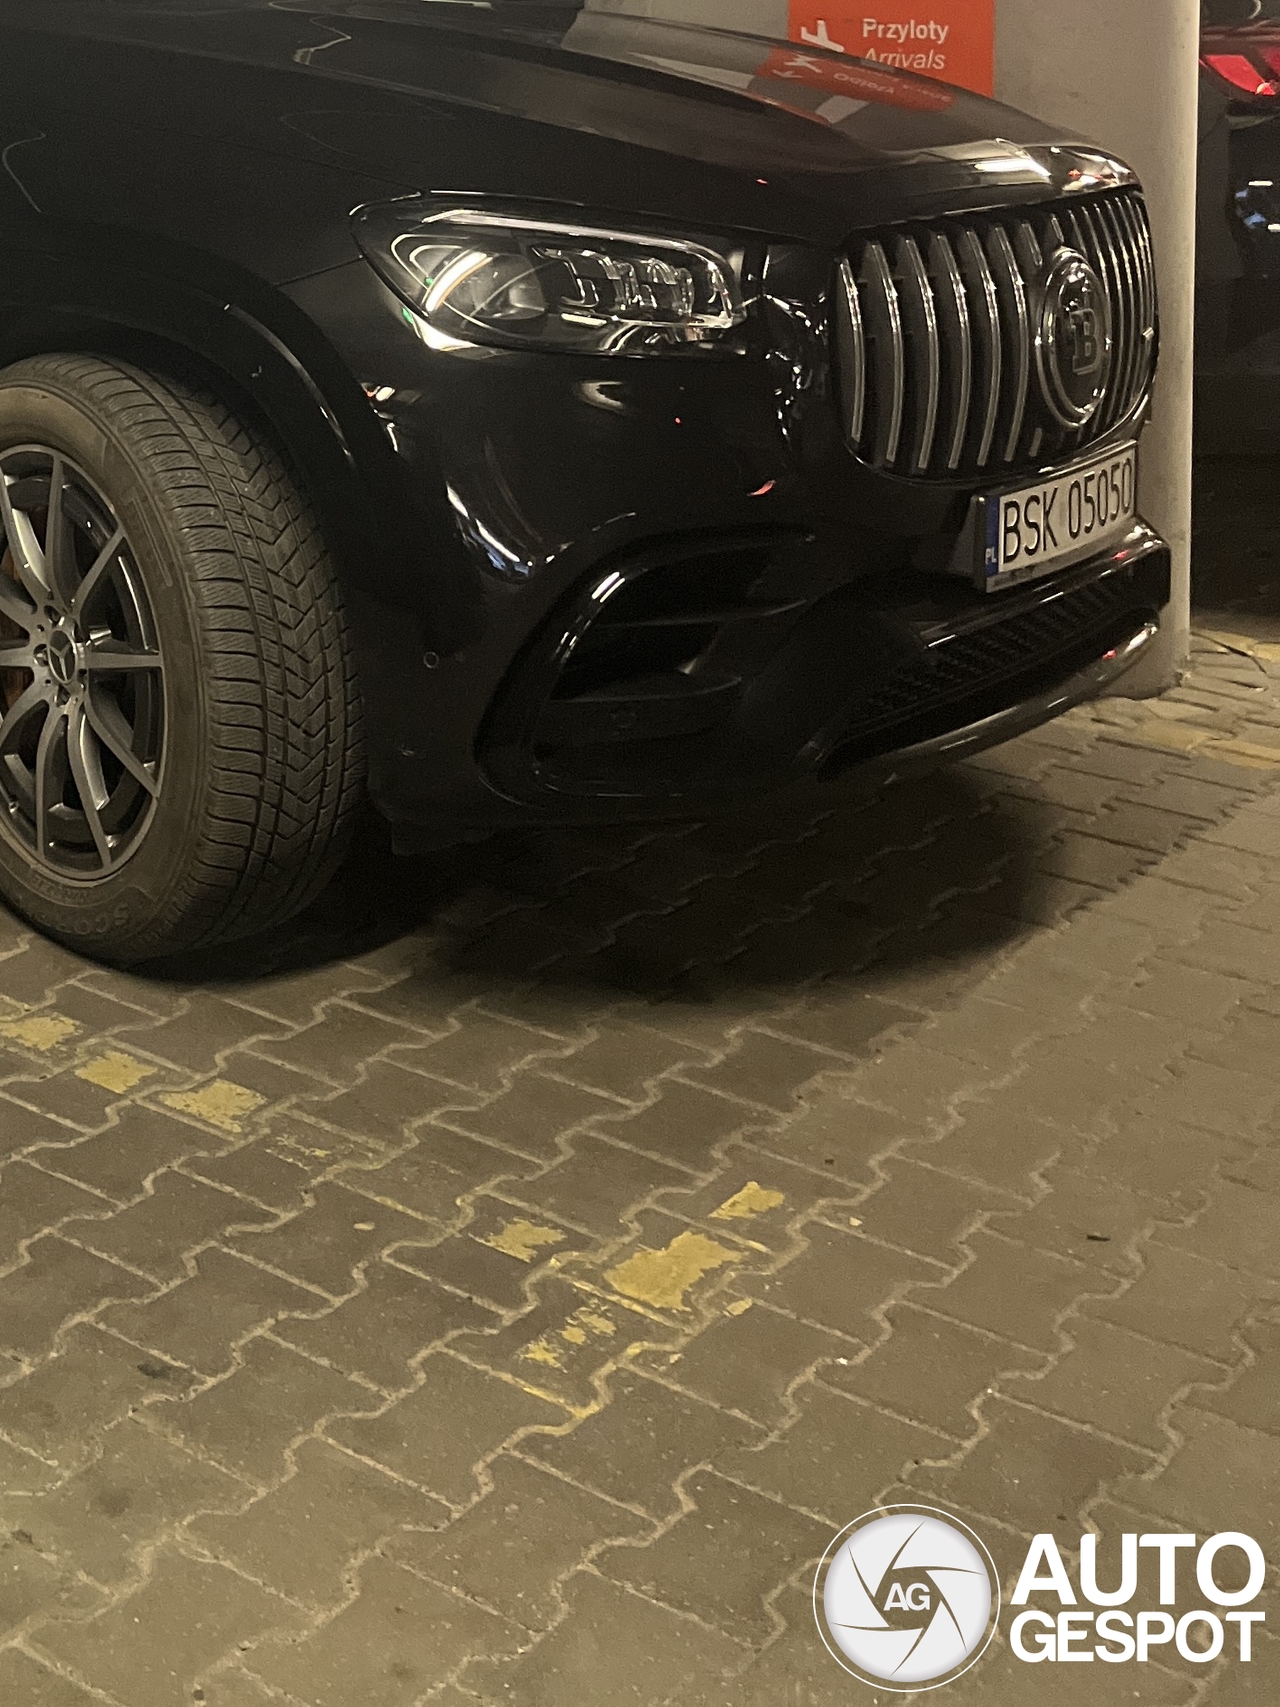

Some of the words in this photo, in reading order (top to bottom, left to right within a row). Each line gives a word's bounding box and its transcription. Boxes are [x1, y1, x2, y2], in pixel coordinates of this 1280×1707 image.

[862, 17, 949, 44] Przyloty
[865, 47, 946, 70] Arrivals
[1002, 487, 1059, 565] BSK
[1068, 458, 1133, 540] 05050
[985, 547, 997, 565] PL
